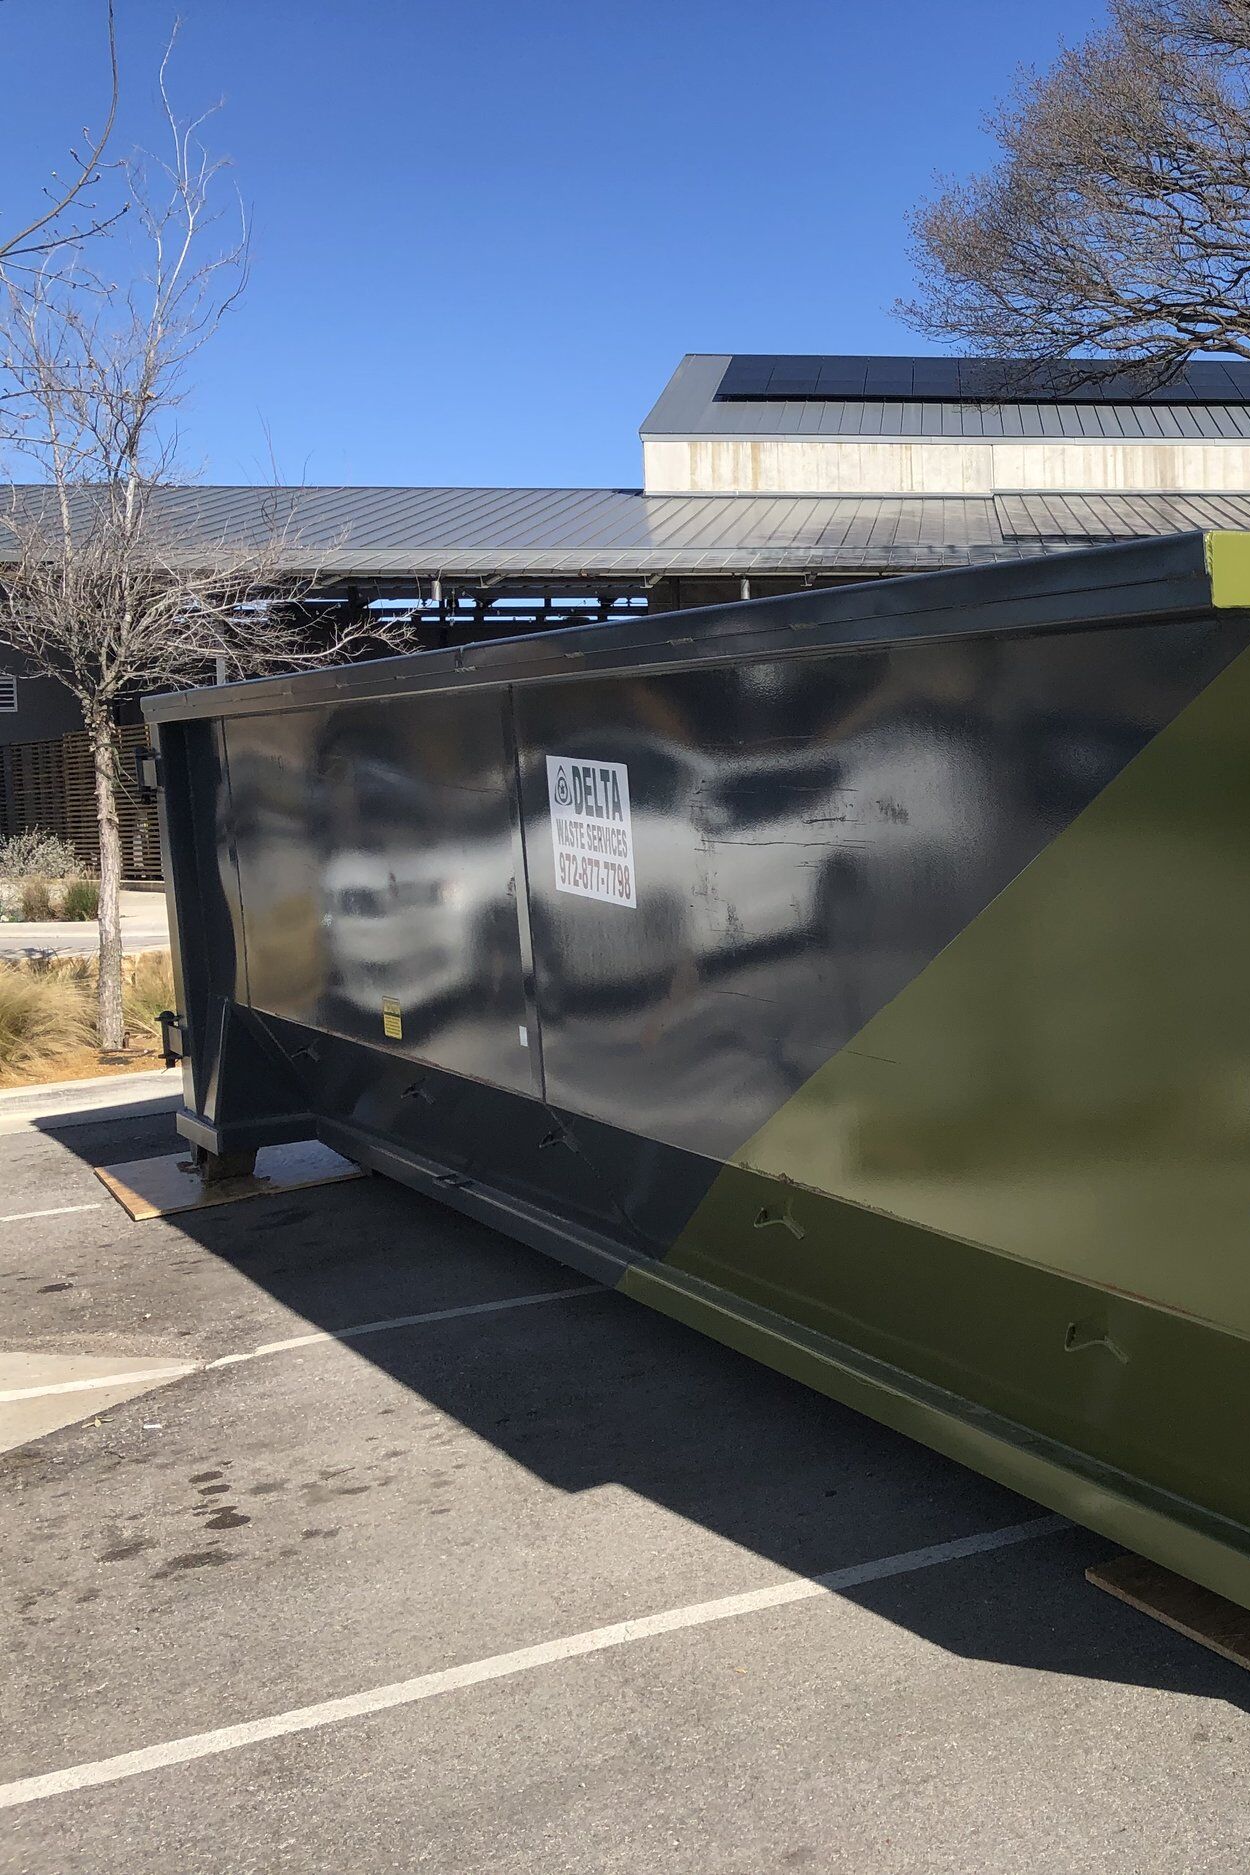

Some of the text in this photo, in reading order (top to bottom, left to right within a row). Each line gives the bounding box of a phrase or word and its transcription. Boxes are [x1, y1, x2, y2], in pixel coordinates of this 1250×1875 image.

[571, 765, 624, 823] DELTA
[555, 818, 628, 859] WASTE SERVICES
[559, 851, 631, 900] 972-877-7798
